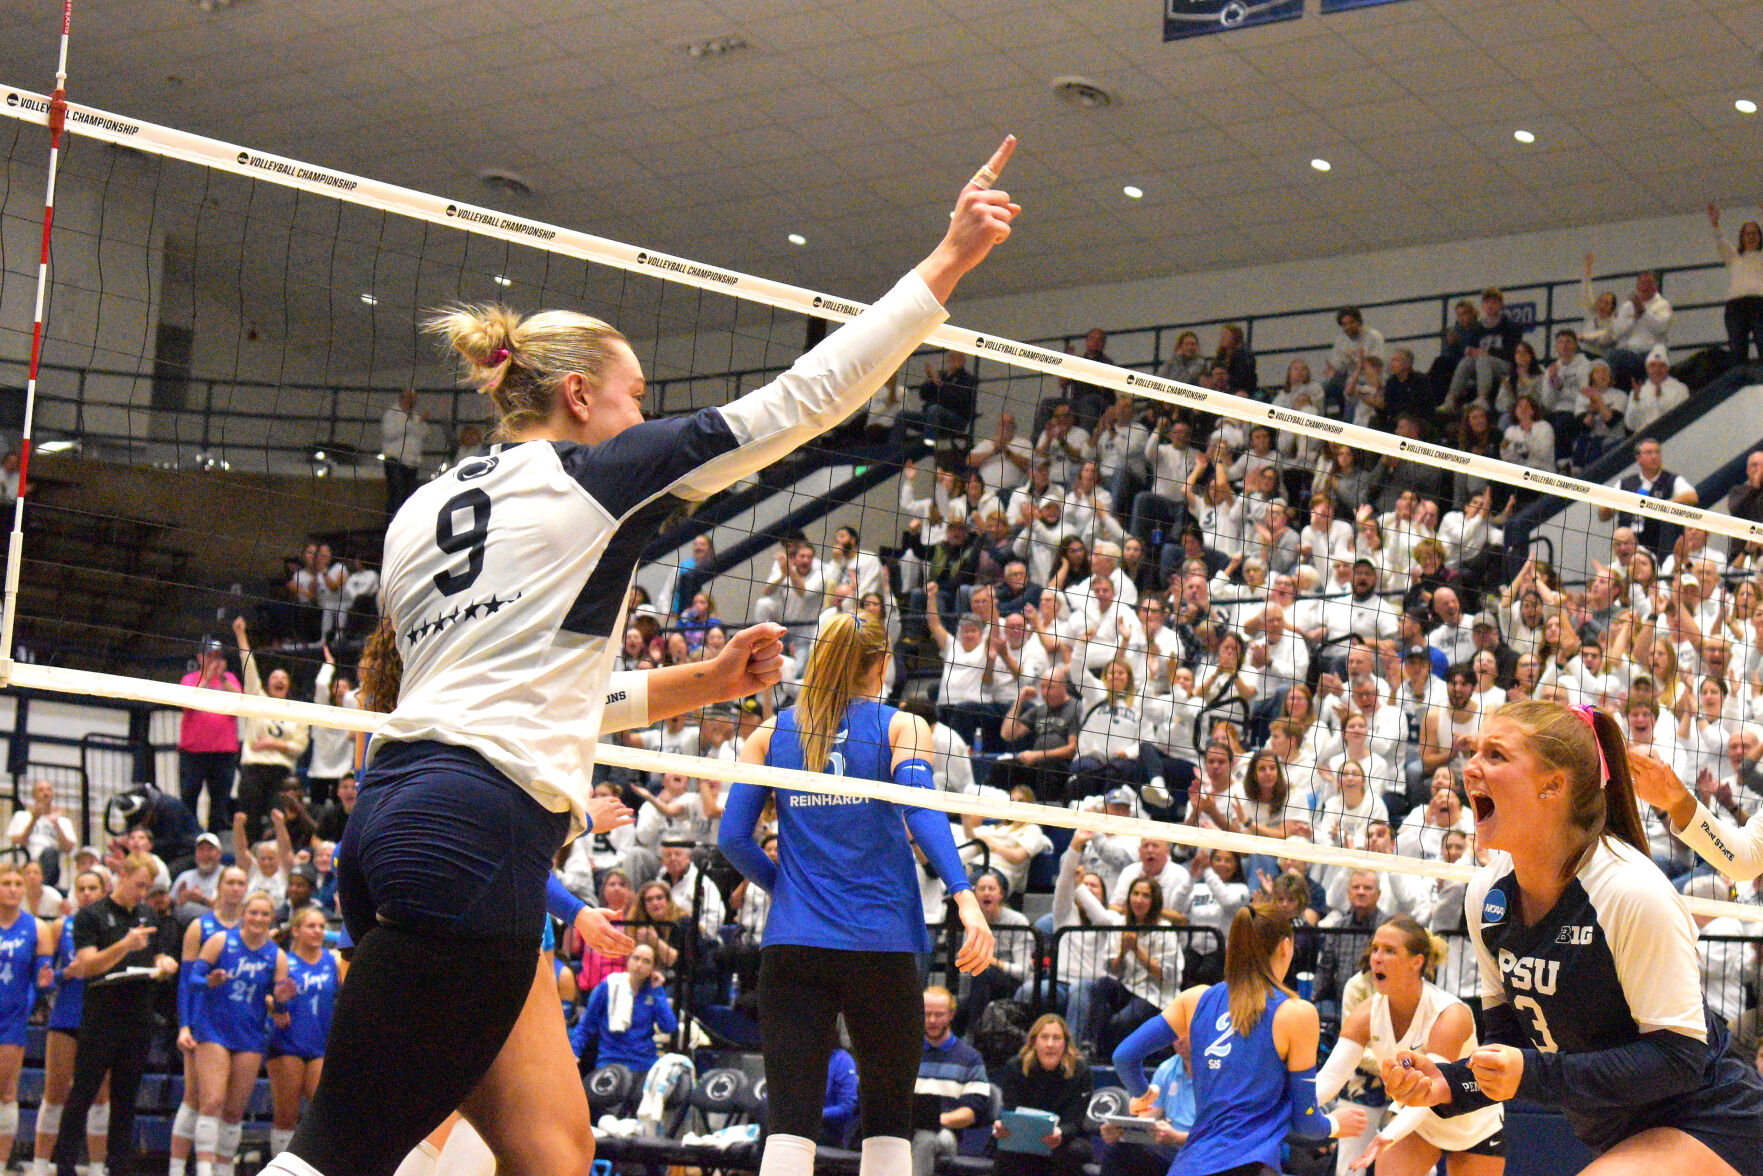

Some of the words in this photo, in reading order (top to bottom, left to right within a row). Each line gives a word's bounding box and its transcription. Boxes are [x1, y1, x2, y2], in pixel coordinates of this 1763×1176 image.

[20, 97, 70, 119] VOLLEYL
[72, 111, 139, 136] CHAMPIONSHIP
[249, 156, 296, 177] VOLLEYBALL
[297, 168, 358, 191] CHAMPIONSHIP
[457, 208, 500, 227] VOLLEYBALL
[500, 219, 556, 241] CHAMPIONSHIP
[647, 256, 687, 274] VOLLEYBALL
[687, 266, 739, 285] CHAMPIONSHIP
[822, 300, 861, 317] VOLLEYBALL
[984, 340, 1019, 356] VOLLEYBALL
[1018, 348, 1063, 366] CHAMPIONSHIP
[1134, 377, 1166, 392] VOLLEYBALL
[1166, 385, 1208, 401] CHAMPIONSHIP
[1275, 411, 1305, 426] VOLLEYBALL
[1304, 418, 1344, 434] CHAMPIONSHIP
[1406, 444, 1434, 458] VOLLEYBALL
[1434, 451, 1471, 465] CHAMPIONSHIP
[433, 488, 491, 597] 9
[789, 794, 870, 808] REINHARDT
[1484, 903, 1506, 916] NCAA
[1498, 947, 1561, 996] PSU
[228, 980, 257, 1004] 21
[1204, 1011, 1234, 1057] 2
[1513, 994, 1559, 1054] 3
